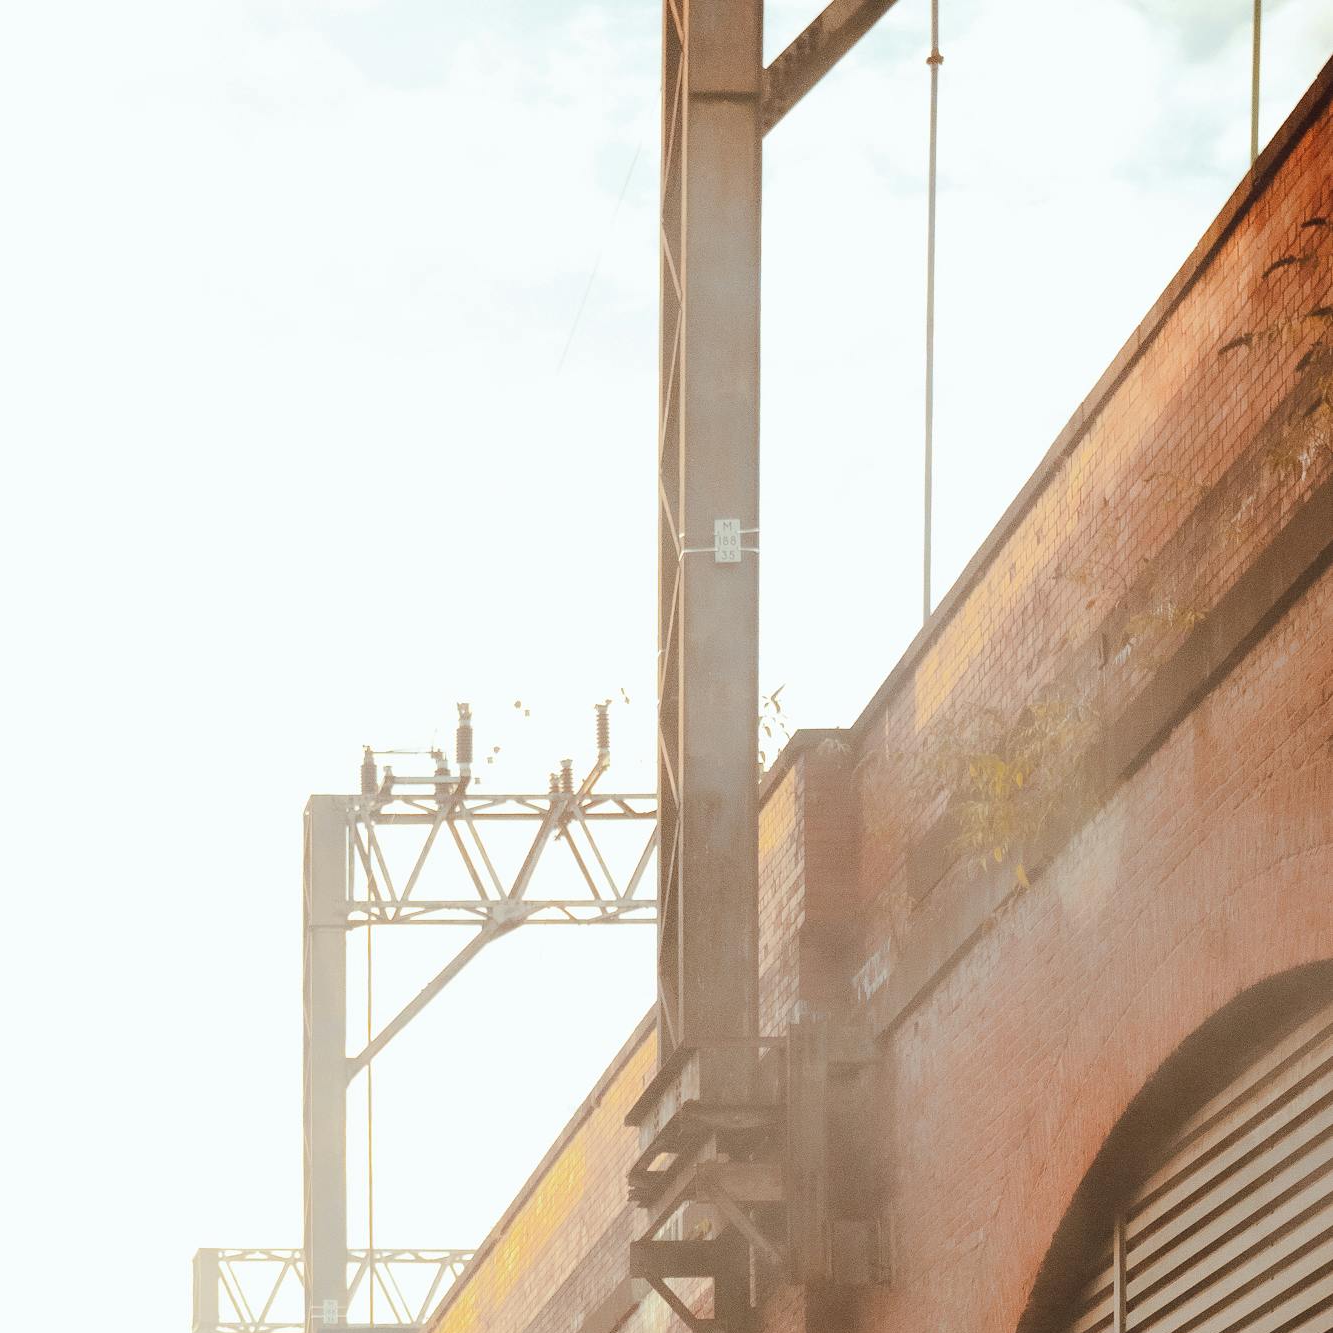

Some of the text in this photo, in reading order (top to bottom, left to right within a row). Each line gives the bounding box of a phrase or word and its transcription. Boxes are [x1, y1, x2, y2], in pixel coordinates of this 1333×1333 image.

[722, 521, 732, 531] M
[718, 535, 737, 546] 188
[721, 550, 736, 560] 35
